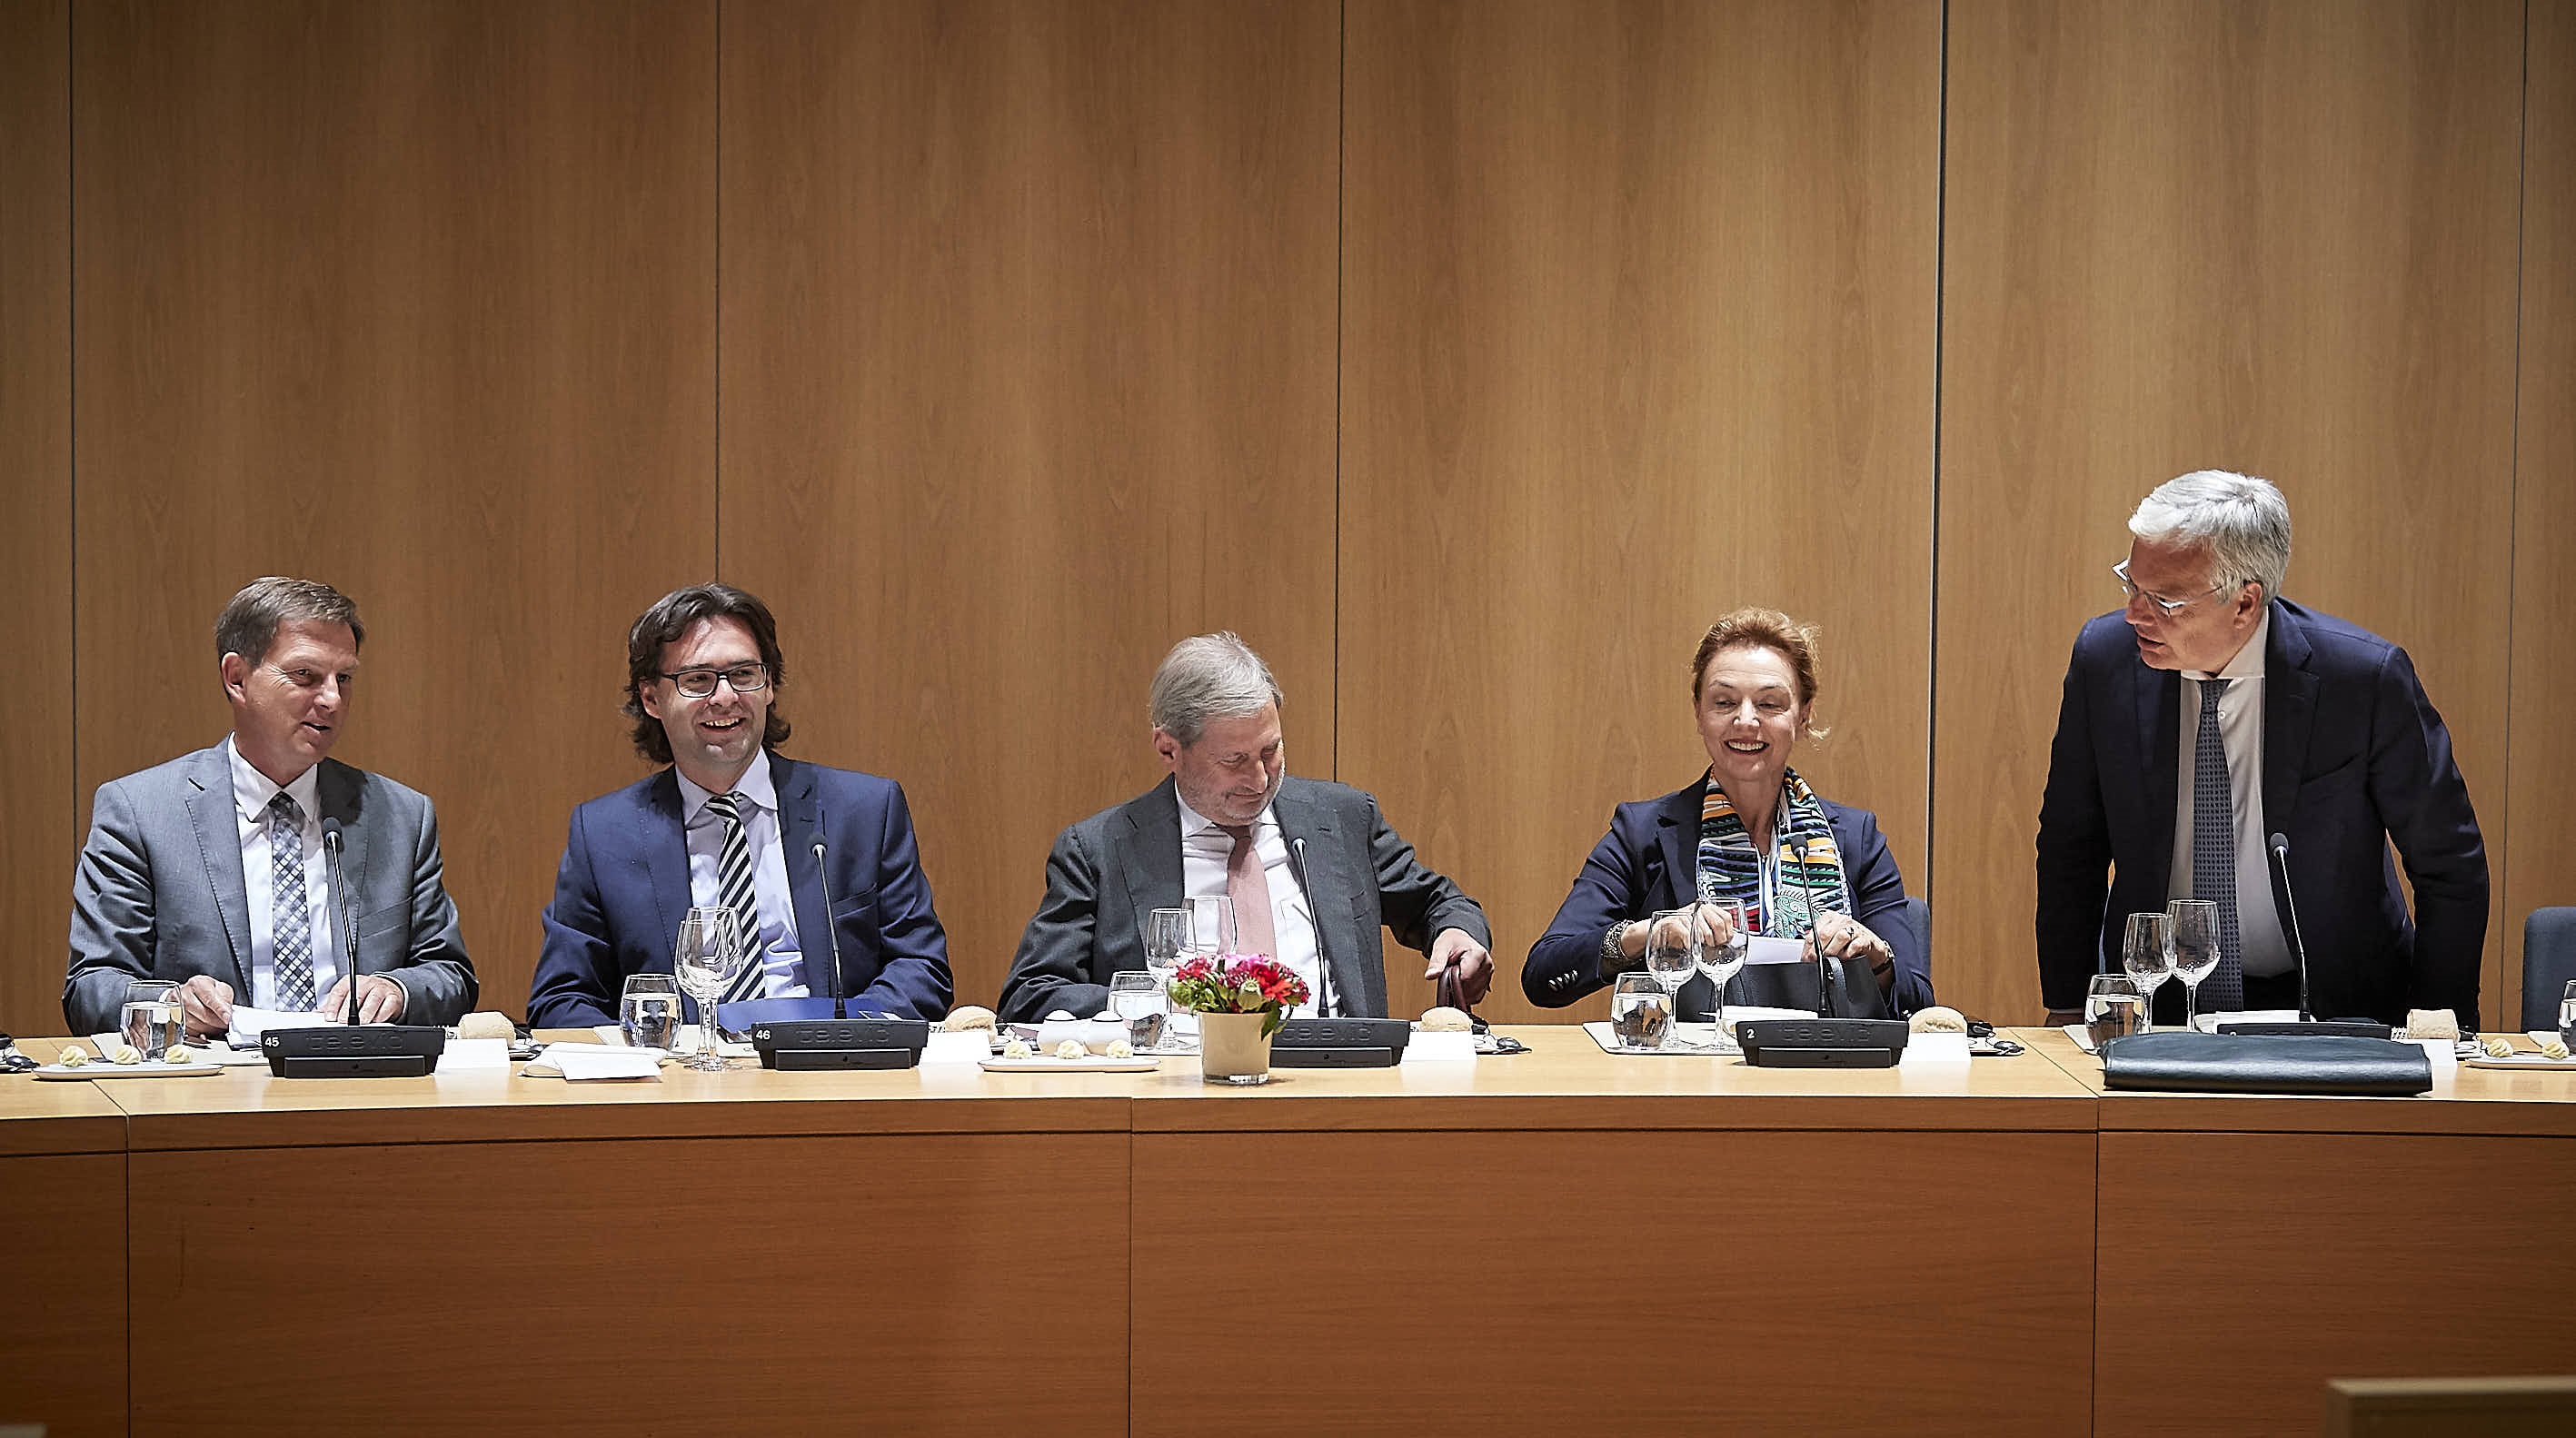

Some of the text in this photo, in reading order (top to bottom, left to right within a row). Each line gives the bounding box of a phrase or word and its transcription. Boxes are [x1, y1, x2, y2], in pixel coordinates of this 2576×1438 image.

[755, 1029, 771, 1040] 46
[1746, 1028, 1755, 1039] 2
[264, 1036, 280, 1046] 45
